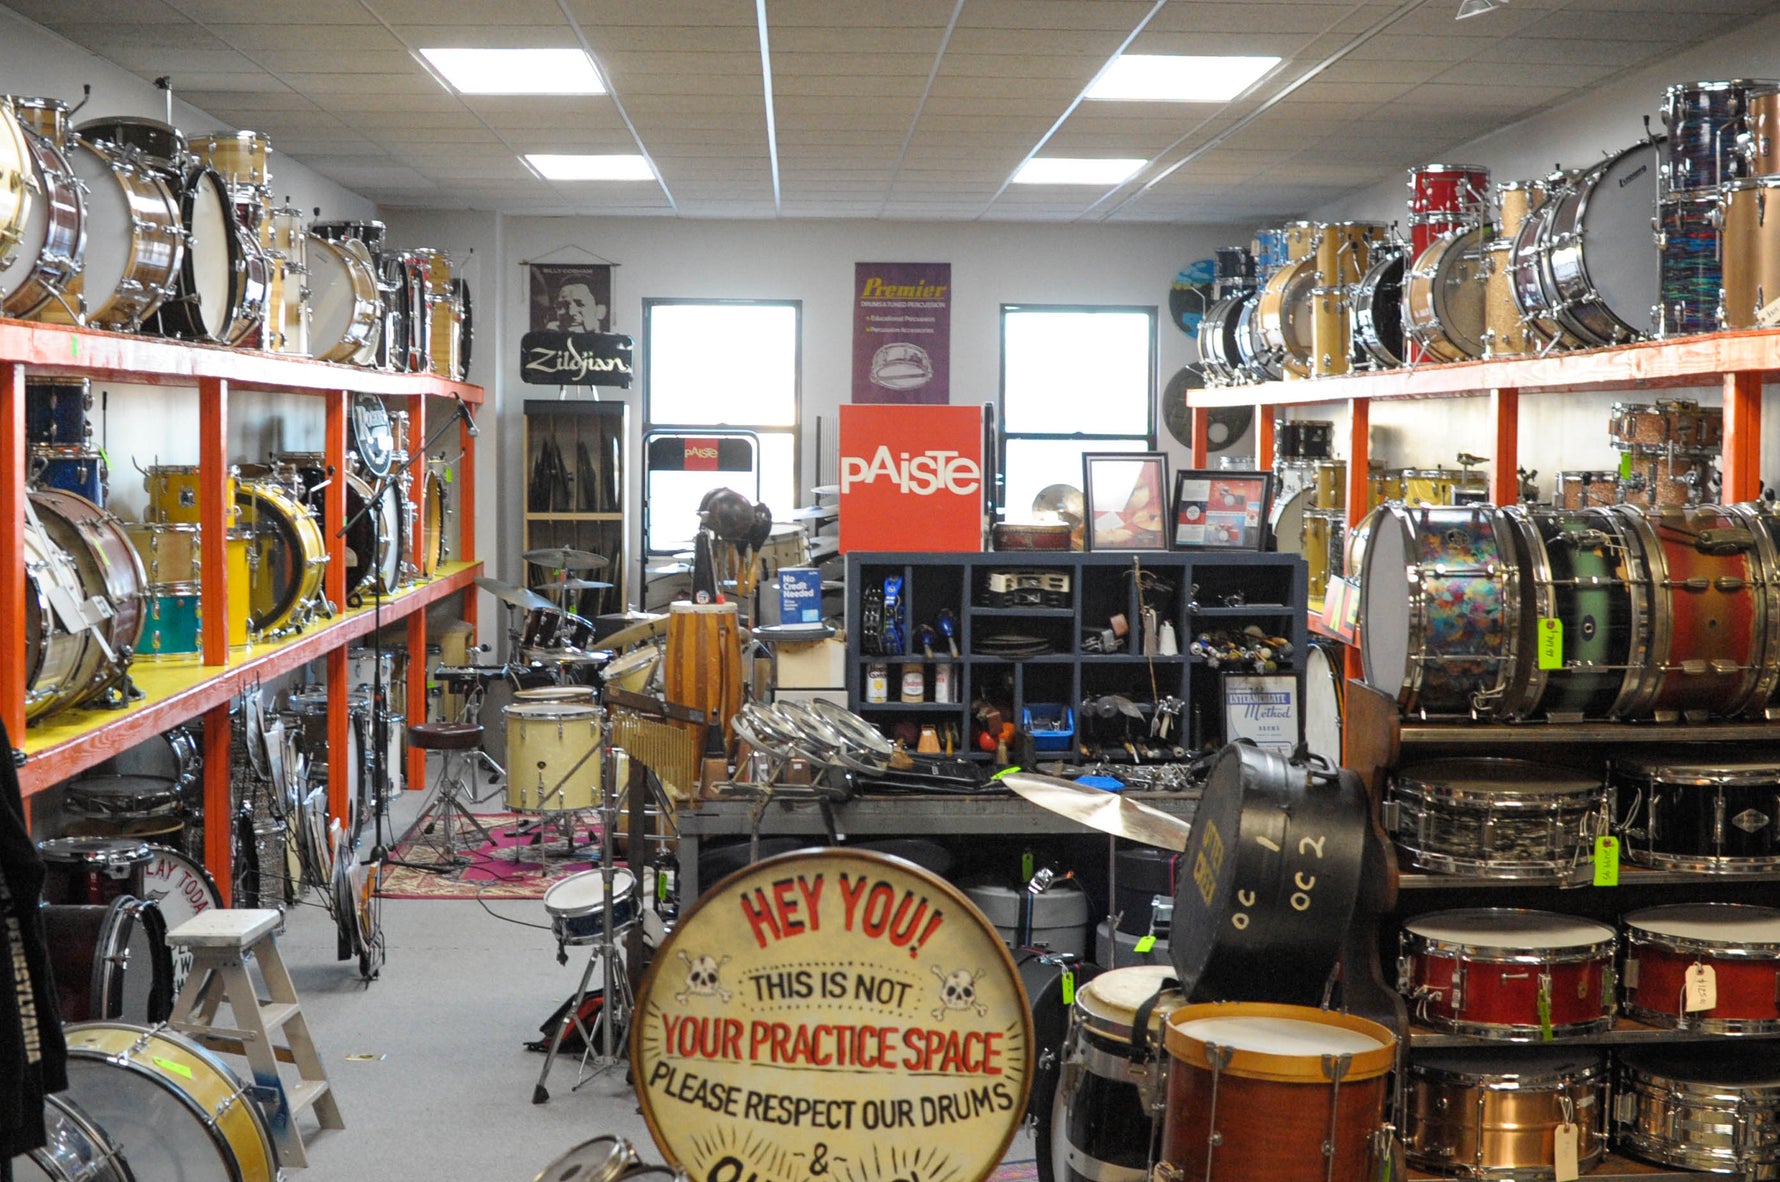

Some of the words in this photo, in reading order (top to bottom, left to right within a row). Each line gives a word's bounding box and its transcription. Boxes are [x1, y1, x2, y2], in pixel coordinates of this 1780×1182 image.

[862, 277, 947, 298] Premier
[525, 337, 632, 381] Zildjian
[783, 575, 796, 583] No
[783, 582, 807, 590] Credit
[783, 589, 815, 598] Needed
[1244, 703, 1291, 721] Method
[144, 859, 178, 880] LAY
[177, 871, 209, 914] TODA
[740, 873, 825, 950] HEY
[838, 872, 945, 960] YOU!
[749, 971, 815, 1002] THIS
[820, 971, 848, 999] IS
[854, 976, 912, 1009] NOT
[661, 1012, 743, 1062] YOUR
[749, 1020, 898, 1070] PRACTICE
[902, 1027, 1004, 1076] SPACE
[648, 1060, 743, 1118] PLEASE
[744, 1095, 856, 1130] RESPECT
[862, 1100, 916, 1130] OUR
[920, 1082, 1014, 1128] DRUMS
[808, 1142, 830, 1177] &
